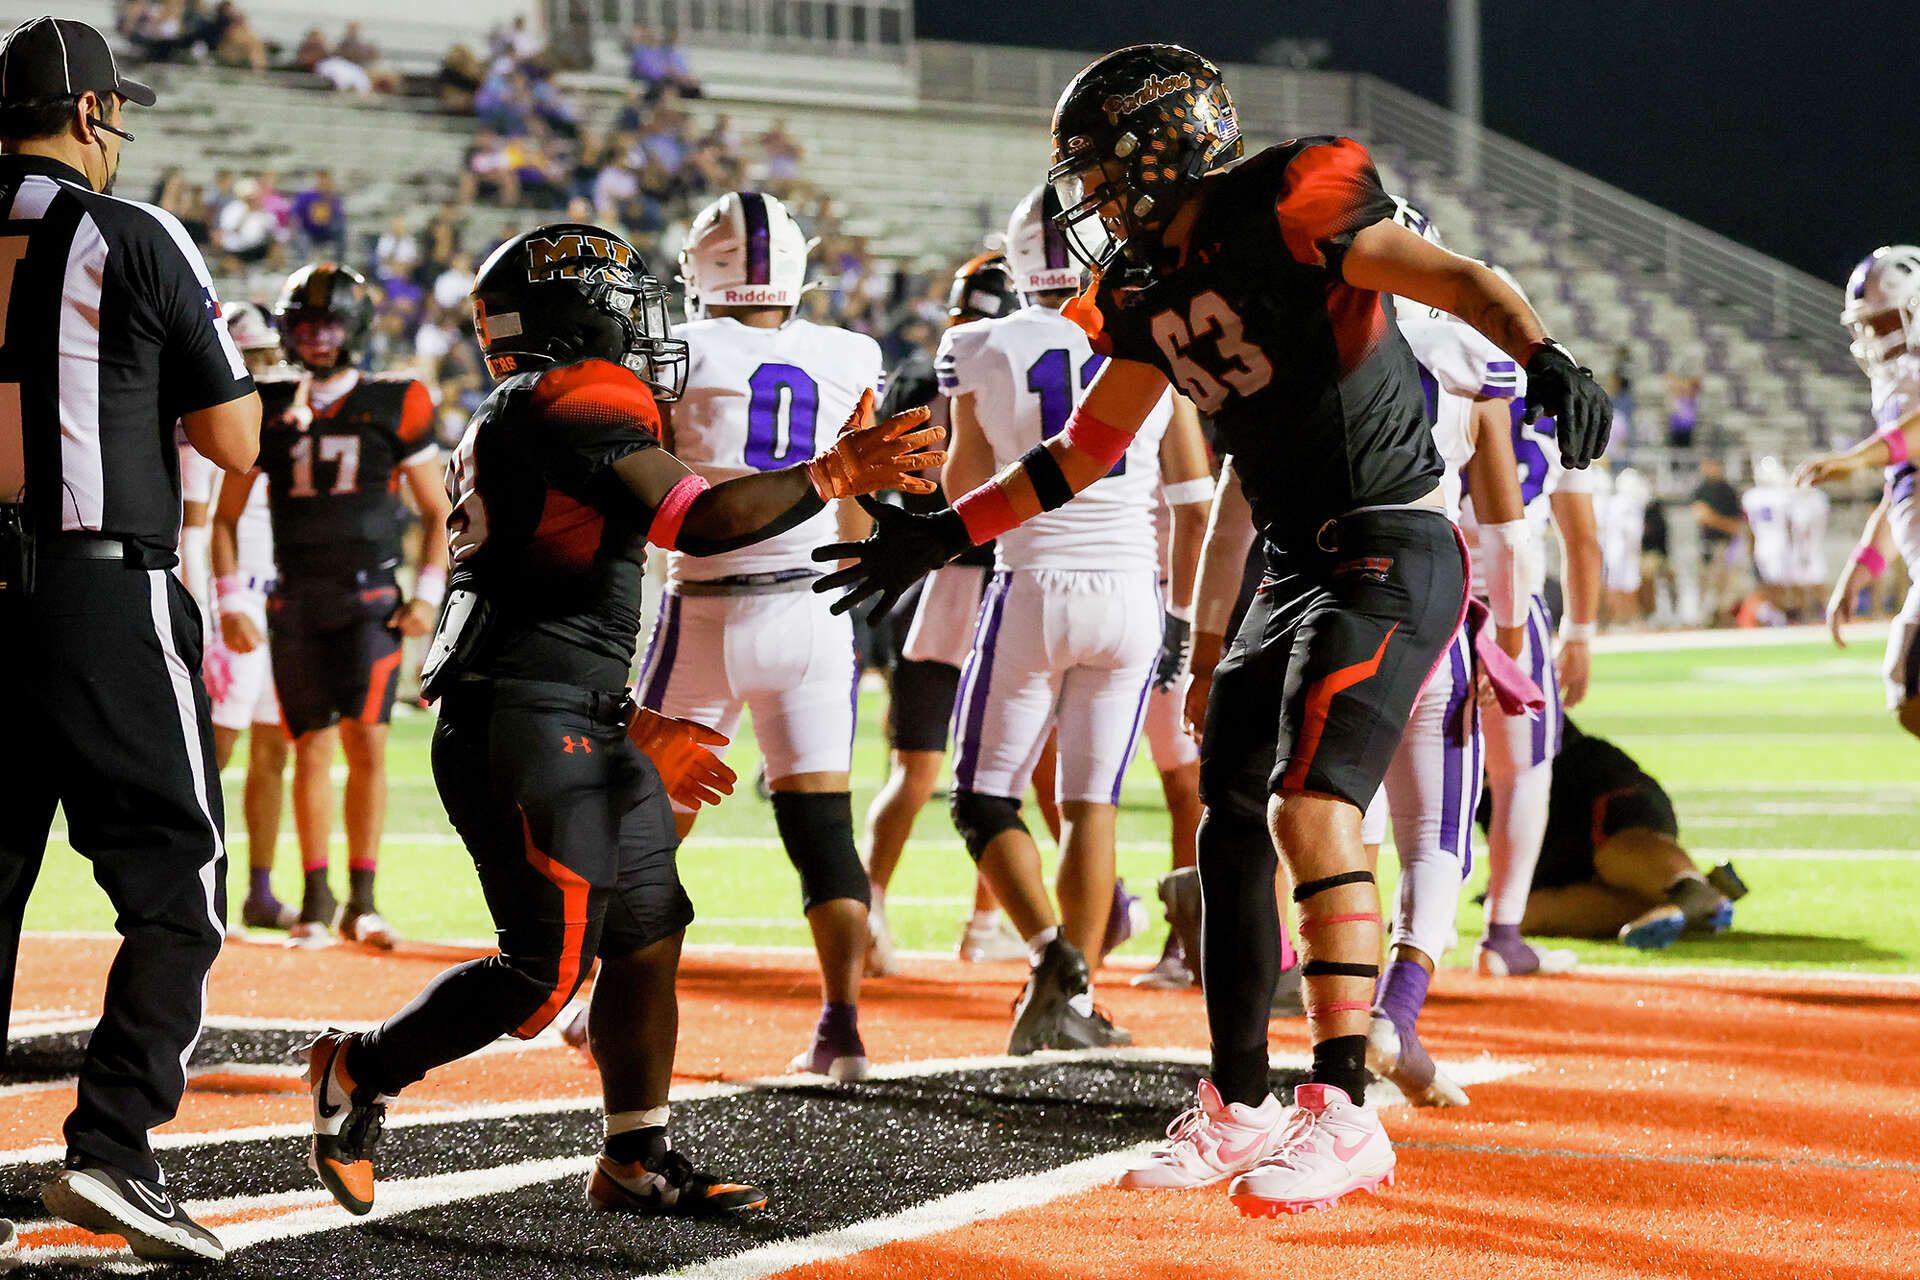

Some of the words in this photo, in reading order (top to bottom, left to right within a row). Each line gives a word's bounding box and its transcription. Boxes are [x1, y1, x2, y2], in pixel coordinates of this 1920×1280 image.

[1102, 71, 1191, 126] Panthers
[725, 290, 787, 302] Riddell
[1029, 274, 1077, 287] Ridde
[1150, 289, 1274, 416] 63
[744, 363, 819, 471] 0
[289, 434, 360, 497] 17
